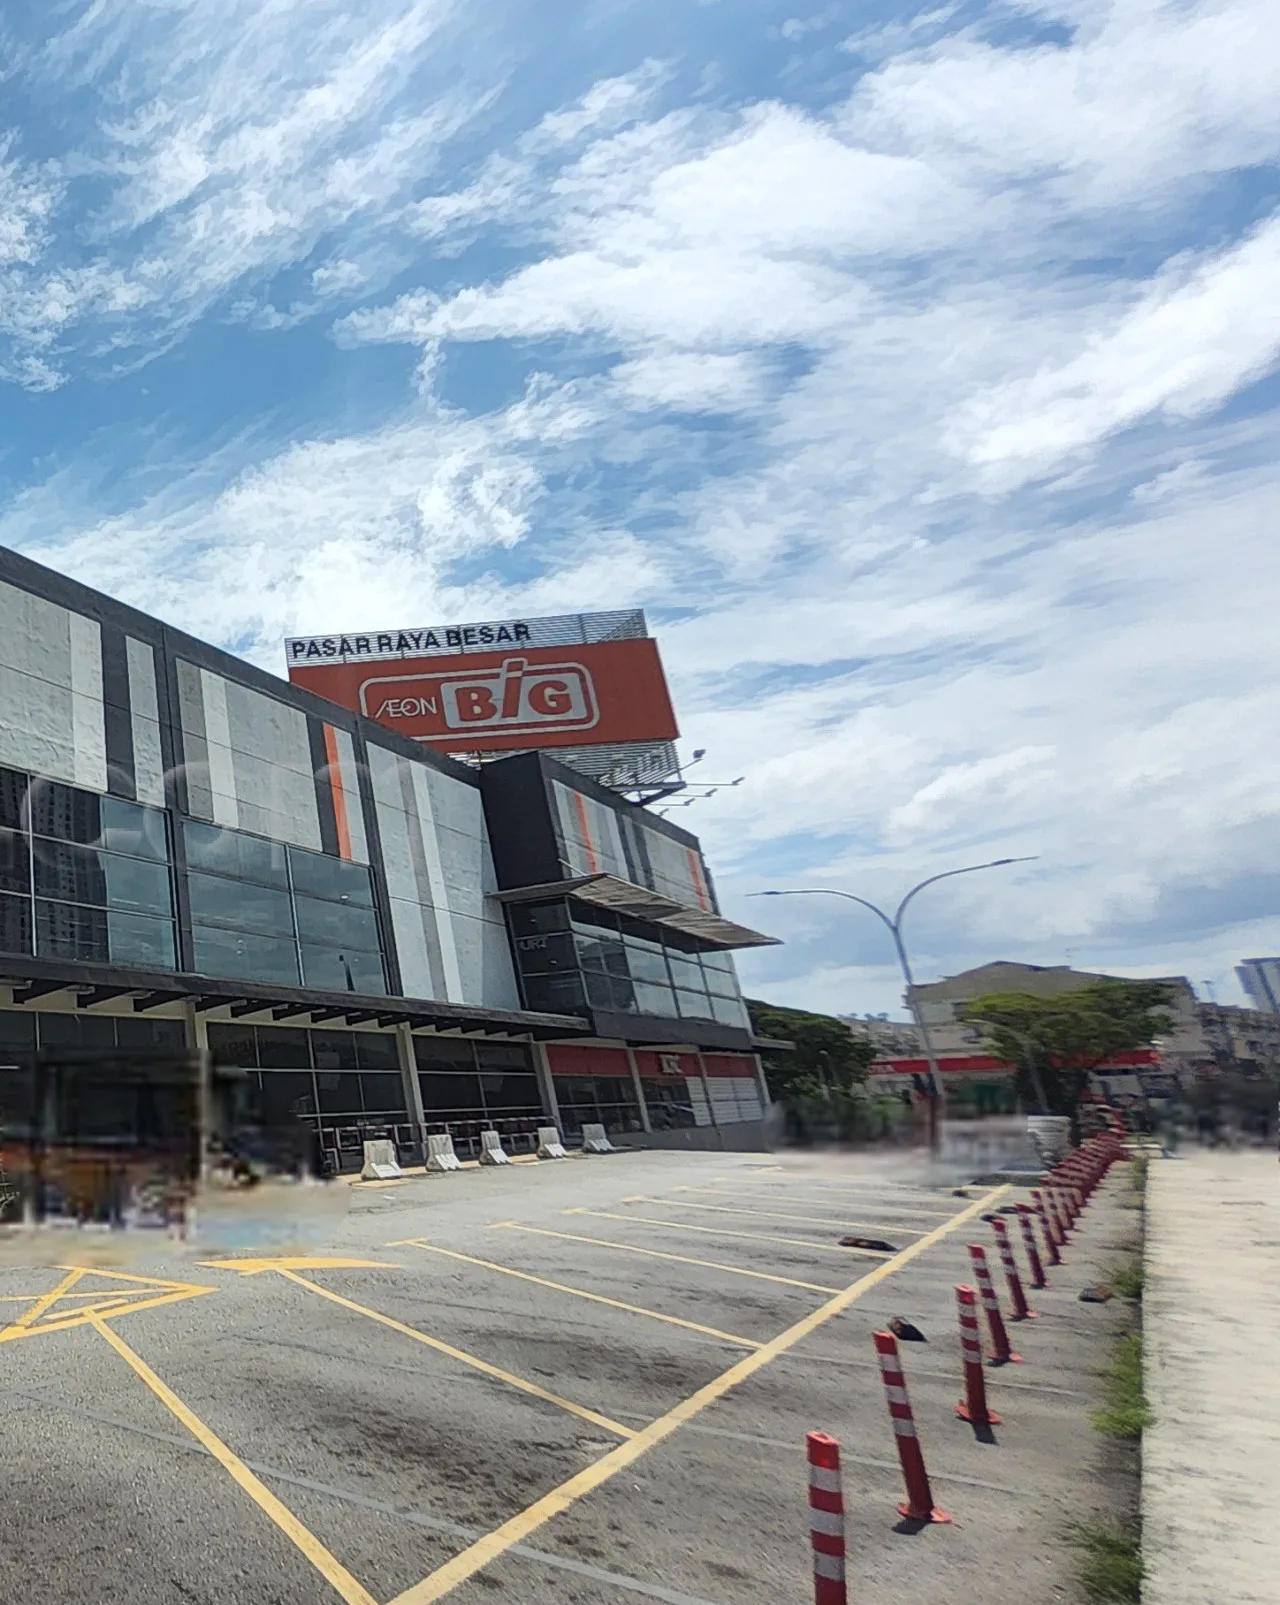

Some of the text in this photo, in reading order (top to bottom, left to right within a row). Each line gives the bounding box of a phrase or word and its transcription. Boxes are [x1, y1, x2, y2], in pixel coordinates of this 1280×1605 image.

[291, 623, 531, 659] PASAR RAYA BESAR
